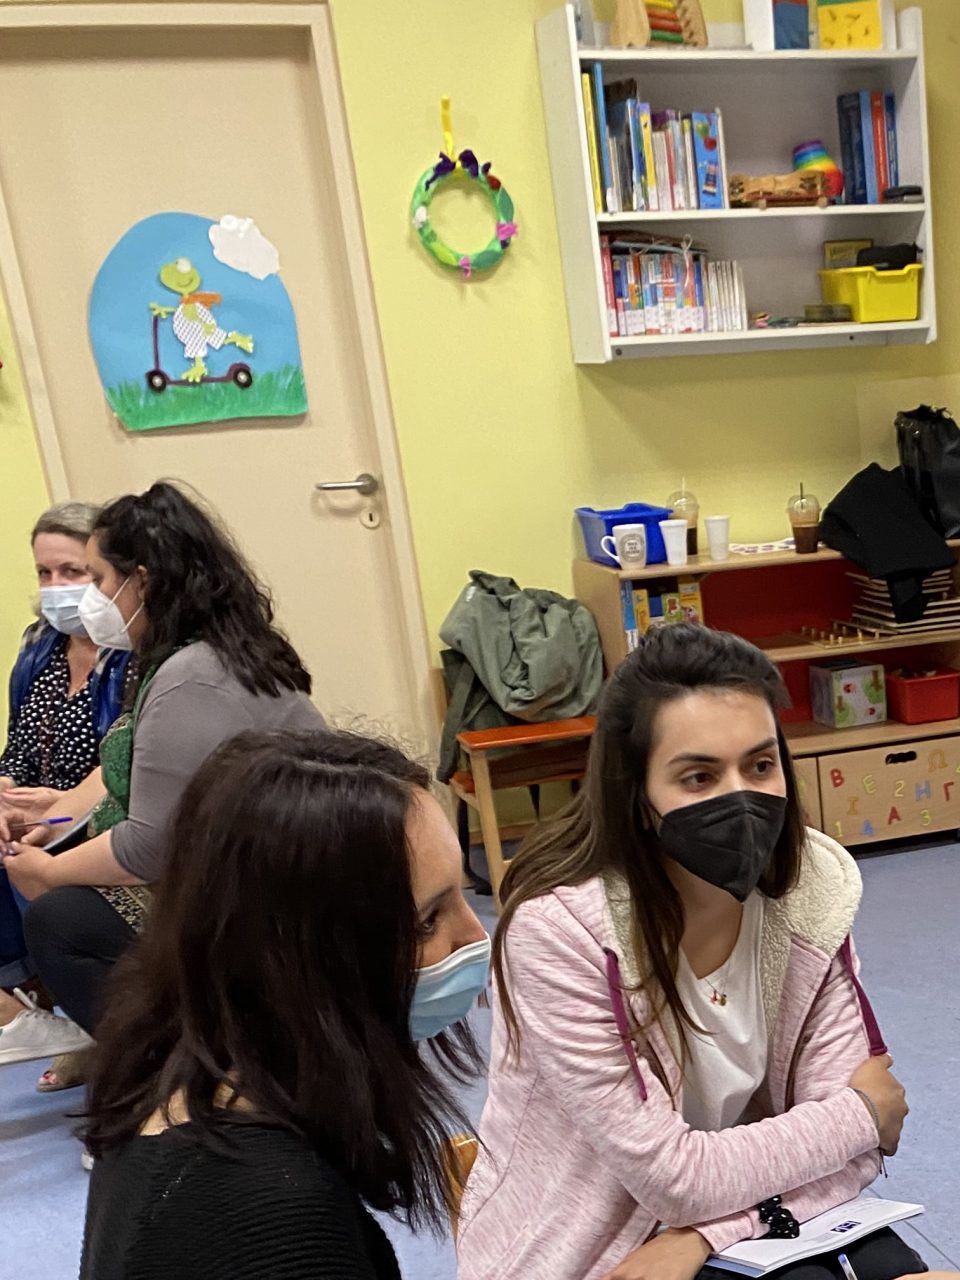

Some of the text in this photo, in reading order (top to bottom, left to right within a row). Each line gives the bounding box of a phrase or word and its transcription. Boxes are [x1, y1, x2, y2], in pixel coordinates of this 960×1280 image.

[894, 780, 905, 797] 2
[919, 809, 932, 826] 3
[834, 820, 844, 838] 1
